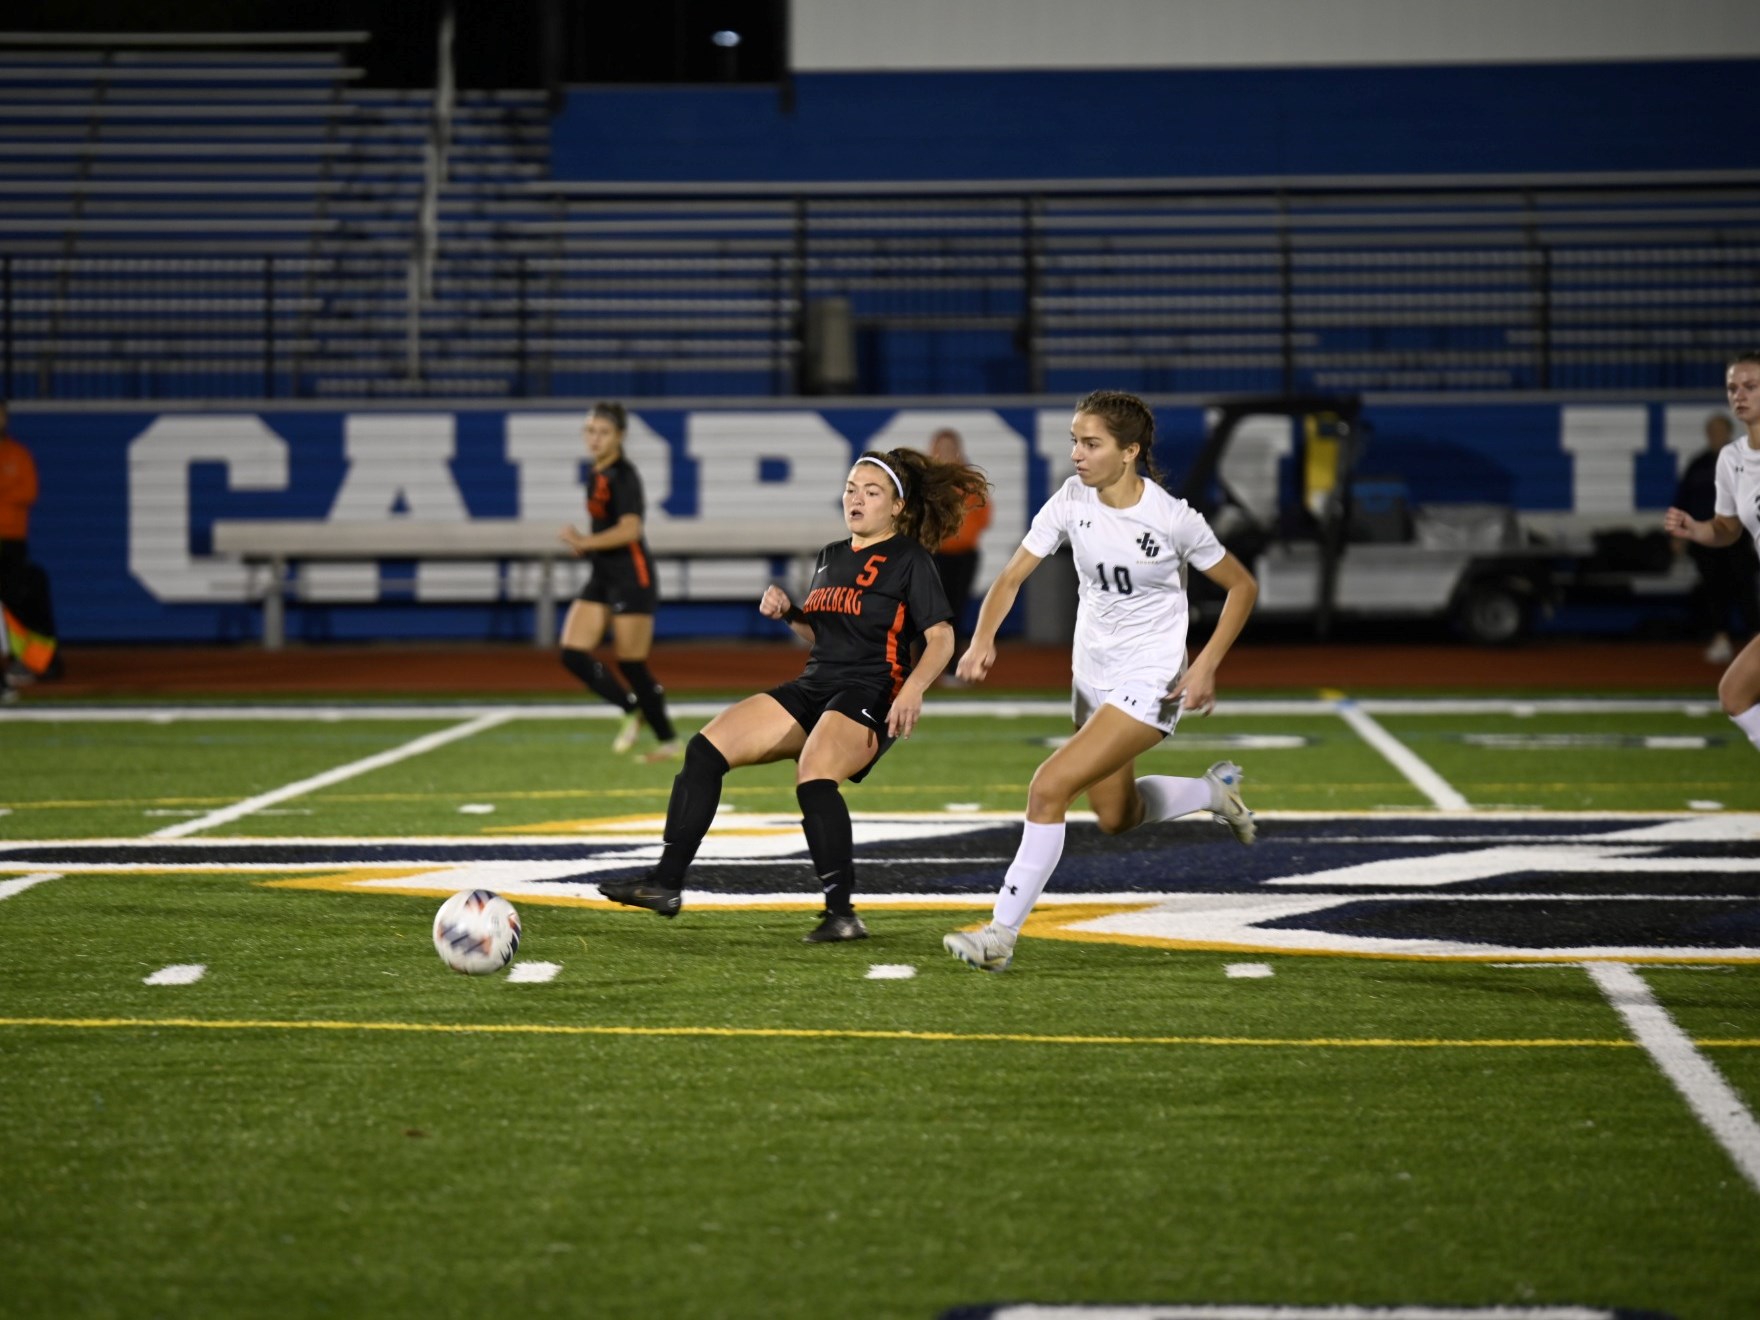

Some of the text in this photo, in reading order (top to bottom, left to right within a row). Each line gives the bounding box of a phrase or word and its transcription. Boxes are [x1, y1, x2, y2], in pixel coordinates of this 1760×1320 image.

[128, 411, 1293, 602] CARRO
[856, 554, 888, 587] 5
[1096, 562, 1132, 595] 10
[803, 586, 863, 616] IDELBERG
